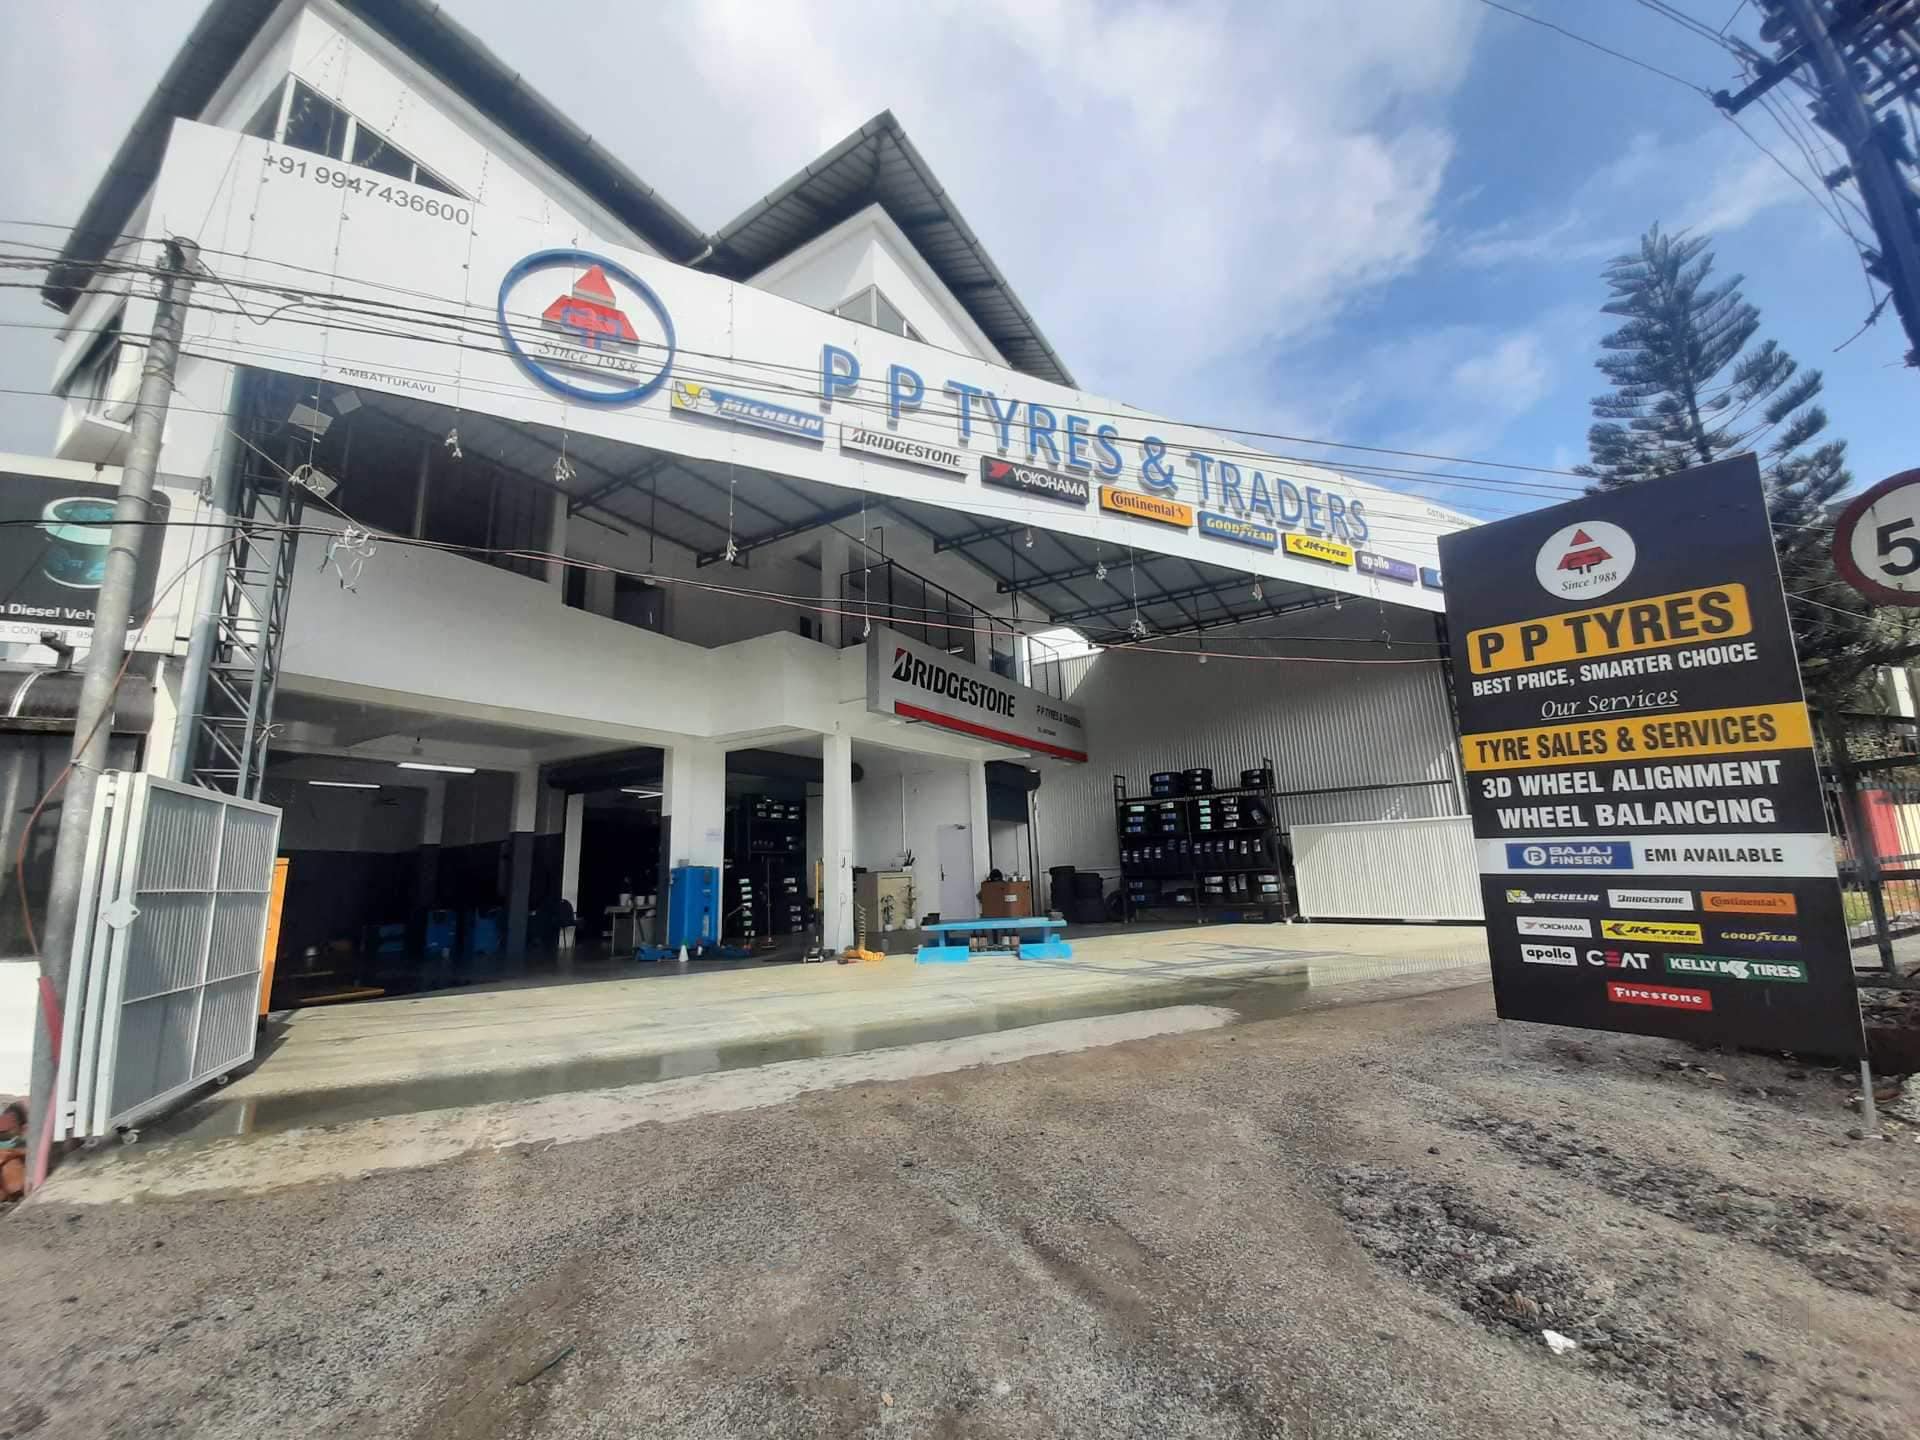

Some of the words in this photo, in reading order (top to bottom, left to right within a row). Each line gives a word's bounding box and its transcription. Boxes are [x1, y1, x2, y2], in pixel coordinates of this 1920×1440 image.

[263, 154, 308, 179] +91
[314, 166, 470, 226] 9947436600
[338, 367, 436, 393] AMBATTUKAVU
[721, 398, 821, 430] MICHELIN
[820, 343, 860, 406] P
[888, 363, 925, 424] P
[944, 379, 1124, 481] TYRES
[1141, 435, 1179, 494] &
[1187, 451, 1370, 543] TRADERS
[850, 428, 961, 467] BRIDGESTONE
[1012, 466, 1087, 498] YOKOHAMA
[1111, 490, 1176, 519] Continental
[1206, 517, 1274, 542] GOODYEAR
[1561, 579, 1590, 592] Since
[1593, 571, 1617, 585] 1988
[8, 603, 59, 618] Diesel
[64, 607, 136, 624] Vehs
[1478, 632, 1504, 669] P
[1520, 624, 1548, 662] P
[1563, 591, 1734, 654] TYRES
[1472, 675, 1512, 697] BEST
[1517, 667, 1575, 691] PRICE,
[1580, 653, 1673, 682] SMARTER
[1677, 642, 1759, 670] CHOICE
[892, 648, 1016, 718] BRIDGESTONE
[1541, 699, 1581, 719] Our
[1587, 689, 1680, 714] Services
[1475, 735, 1531, 764] TYRE
[1536, 728, 1608, 760] SALES
[1616, 726, 1637, 753] &
[1641, 713, 1777, 750] SERVICES
[1482, 777, 1512, 799] 3D
[1518, 770, 1604, 797] WHEEL
[1612, 759, 1781, 792] ALIGNMENT
[1497, 805, 1589, 830] WHEEL
[1596, 798, 1776, 827] BALANCING
[1549, 845, 1613, 855] BAJAJ
[1550, 855, 1614, 866] FINSERV
[1645, 848, 1677, 862] EMI
[1683, 847, 1784, 863] AVAILABLE
[1533, 893, 1600, 902] MICHELIN
[1617, 894, 1685, 905] BRIDGESTONE
[1711, 896, 1777, 907] Continental
[1538, 923, 1585, 932] YOKOHAMA
[1721, 931, 1798, 943] GOODYEAR
[1526, 947, 1572, 960] apollo
[1586, 949, 1650, 970] CEAT
[1669, 957, 1717, 972] KELLY
[1749, 963, 1802, 978] TIRES
[1613, 986, 1703, 1004] Firestone
